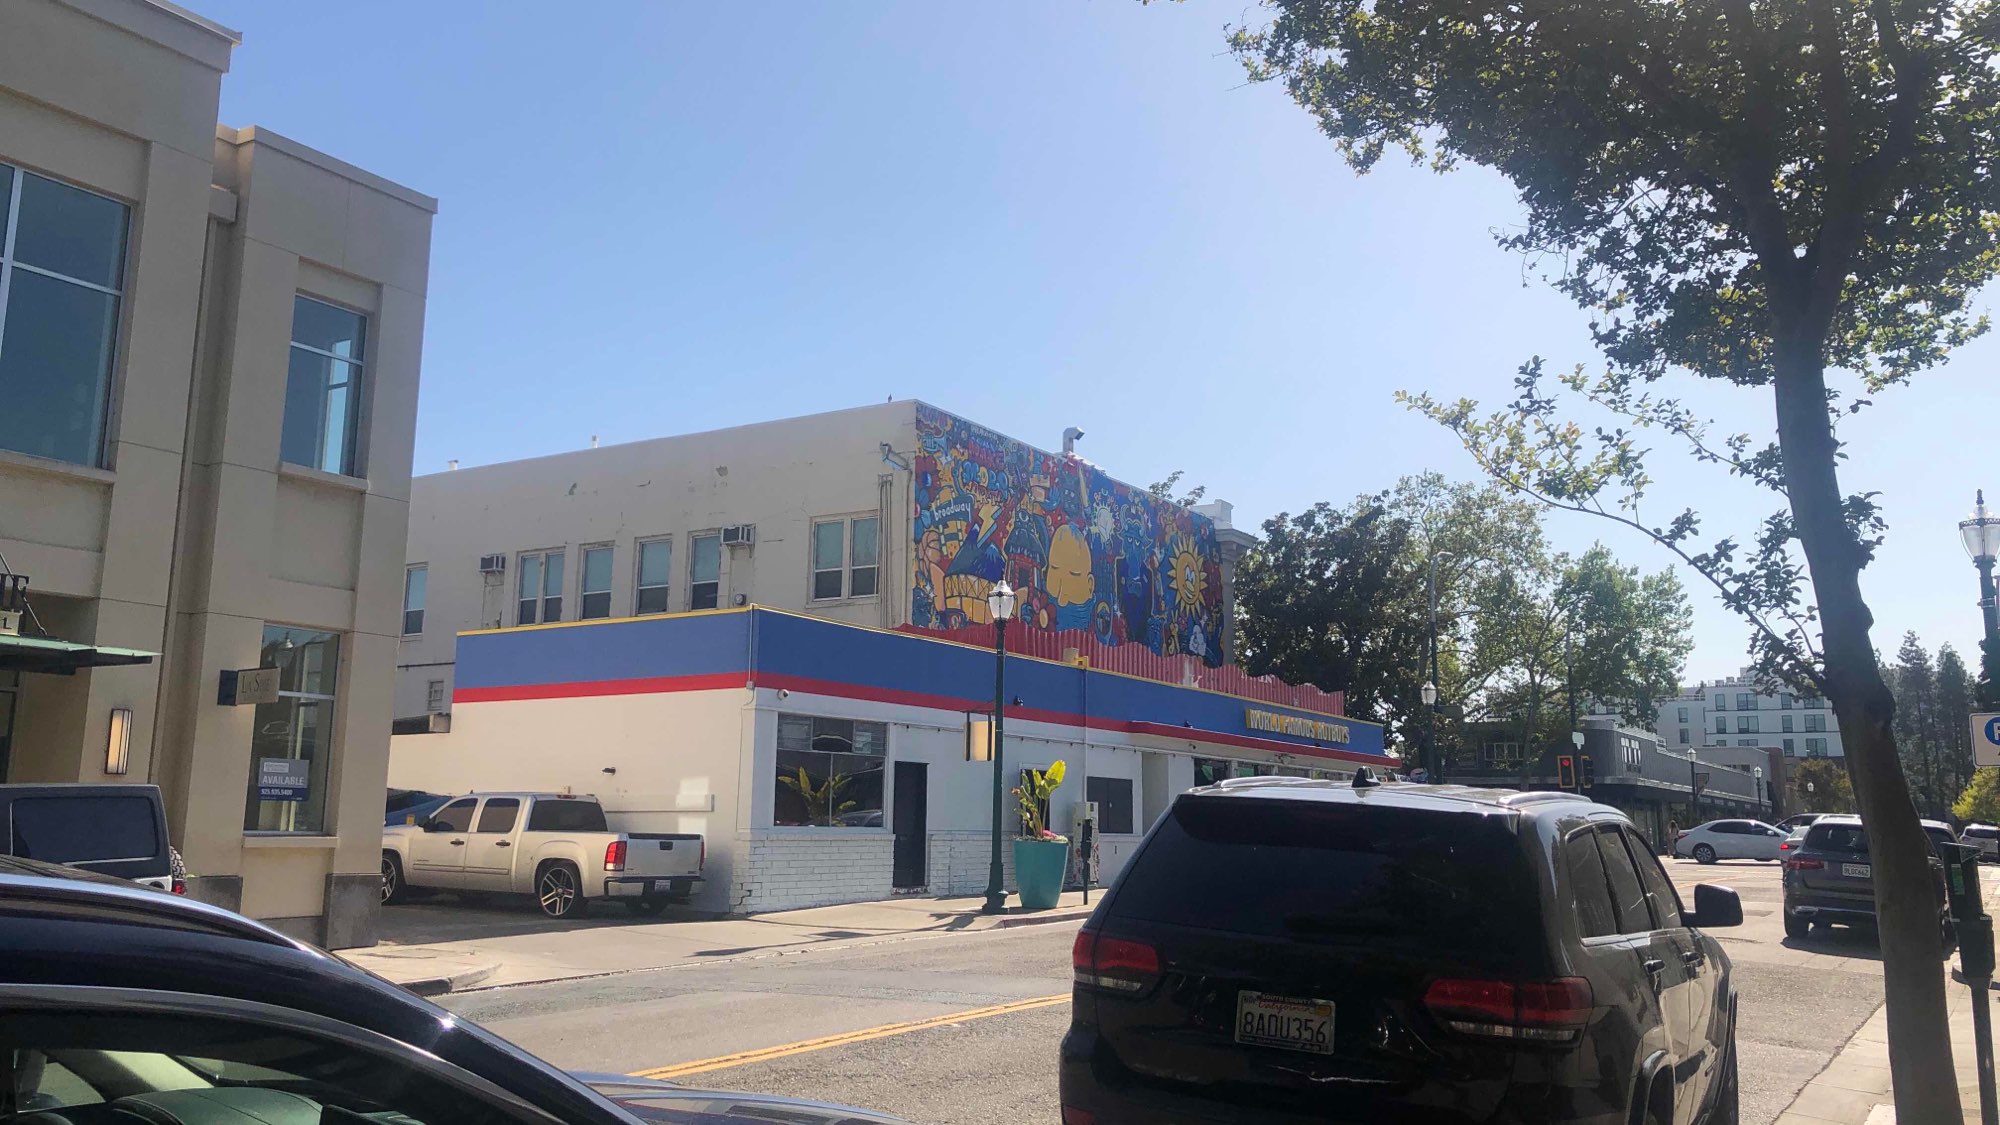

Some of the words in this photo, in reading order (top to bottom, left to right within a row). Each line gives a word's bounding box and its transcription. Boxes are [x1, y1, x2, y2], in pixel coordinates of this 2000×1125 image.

[931, 497, 971, 523] broadway
[1247, 708, 1280, 731] WORLD
[1282, 715, 1315, 737] FAMOUS
[1317, 722, 1350, 744] HOTBOYS
[262, 775, 305, 786] AVAILABLE
[1262, 993, 1284, 1002] SOUTH
[1243, 1012, 1327, 1044] 8ADU356
